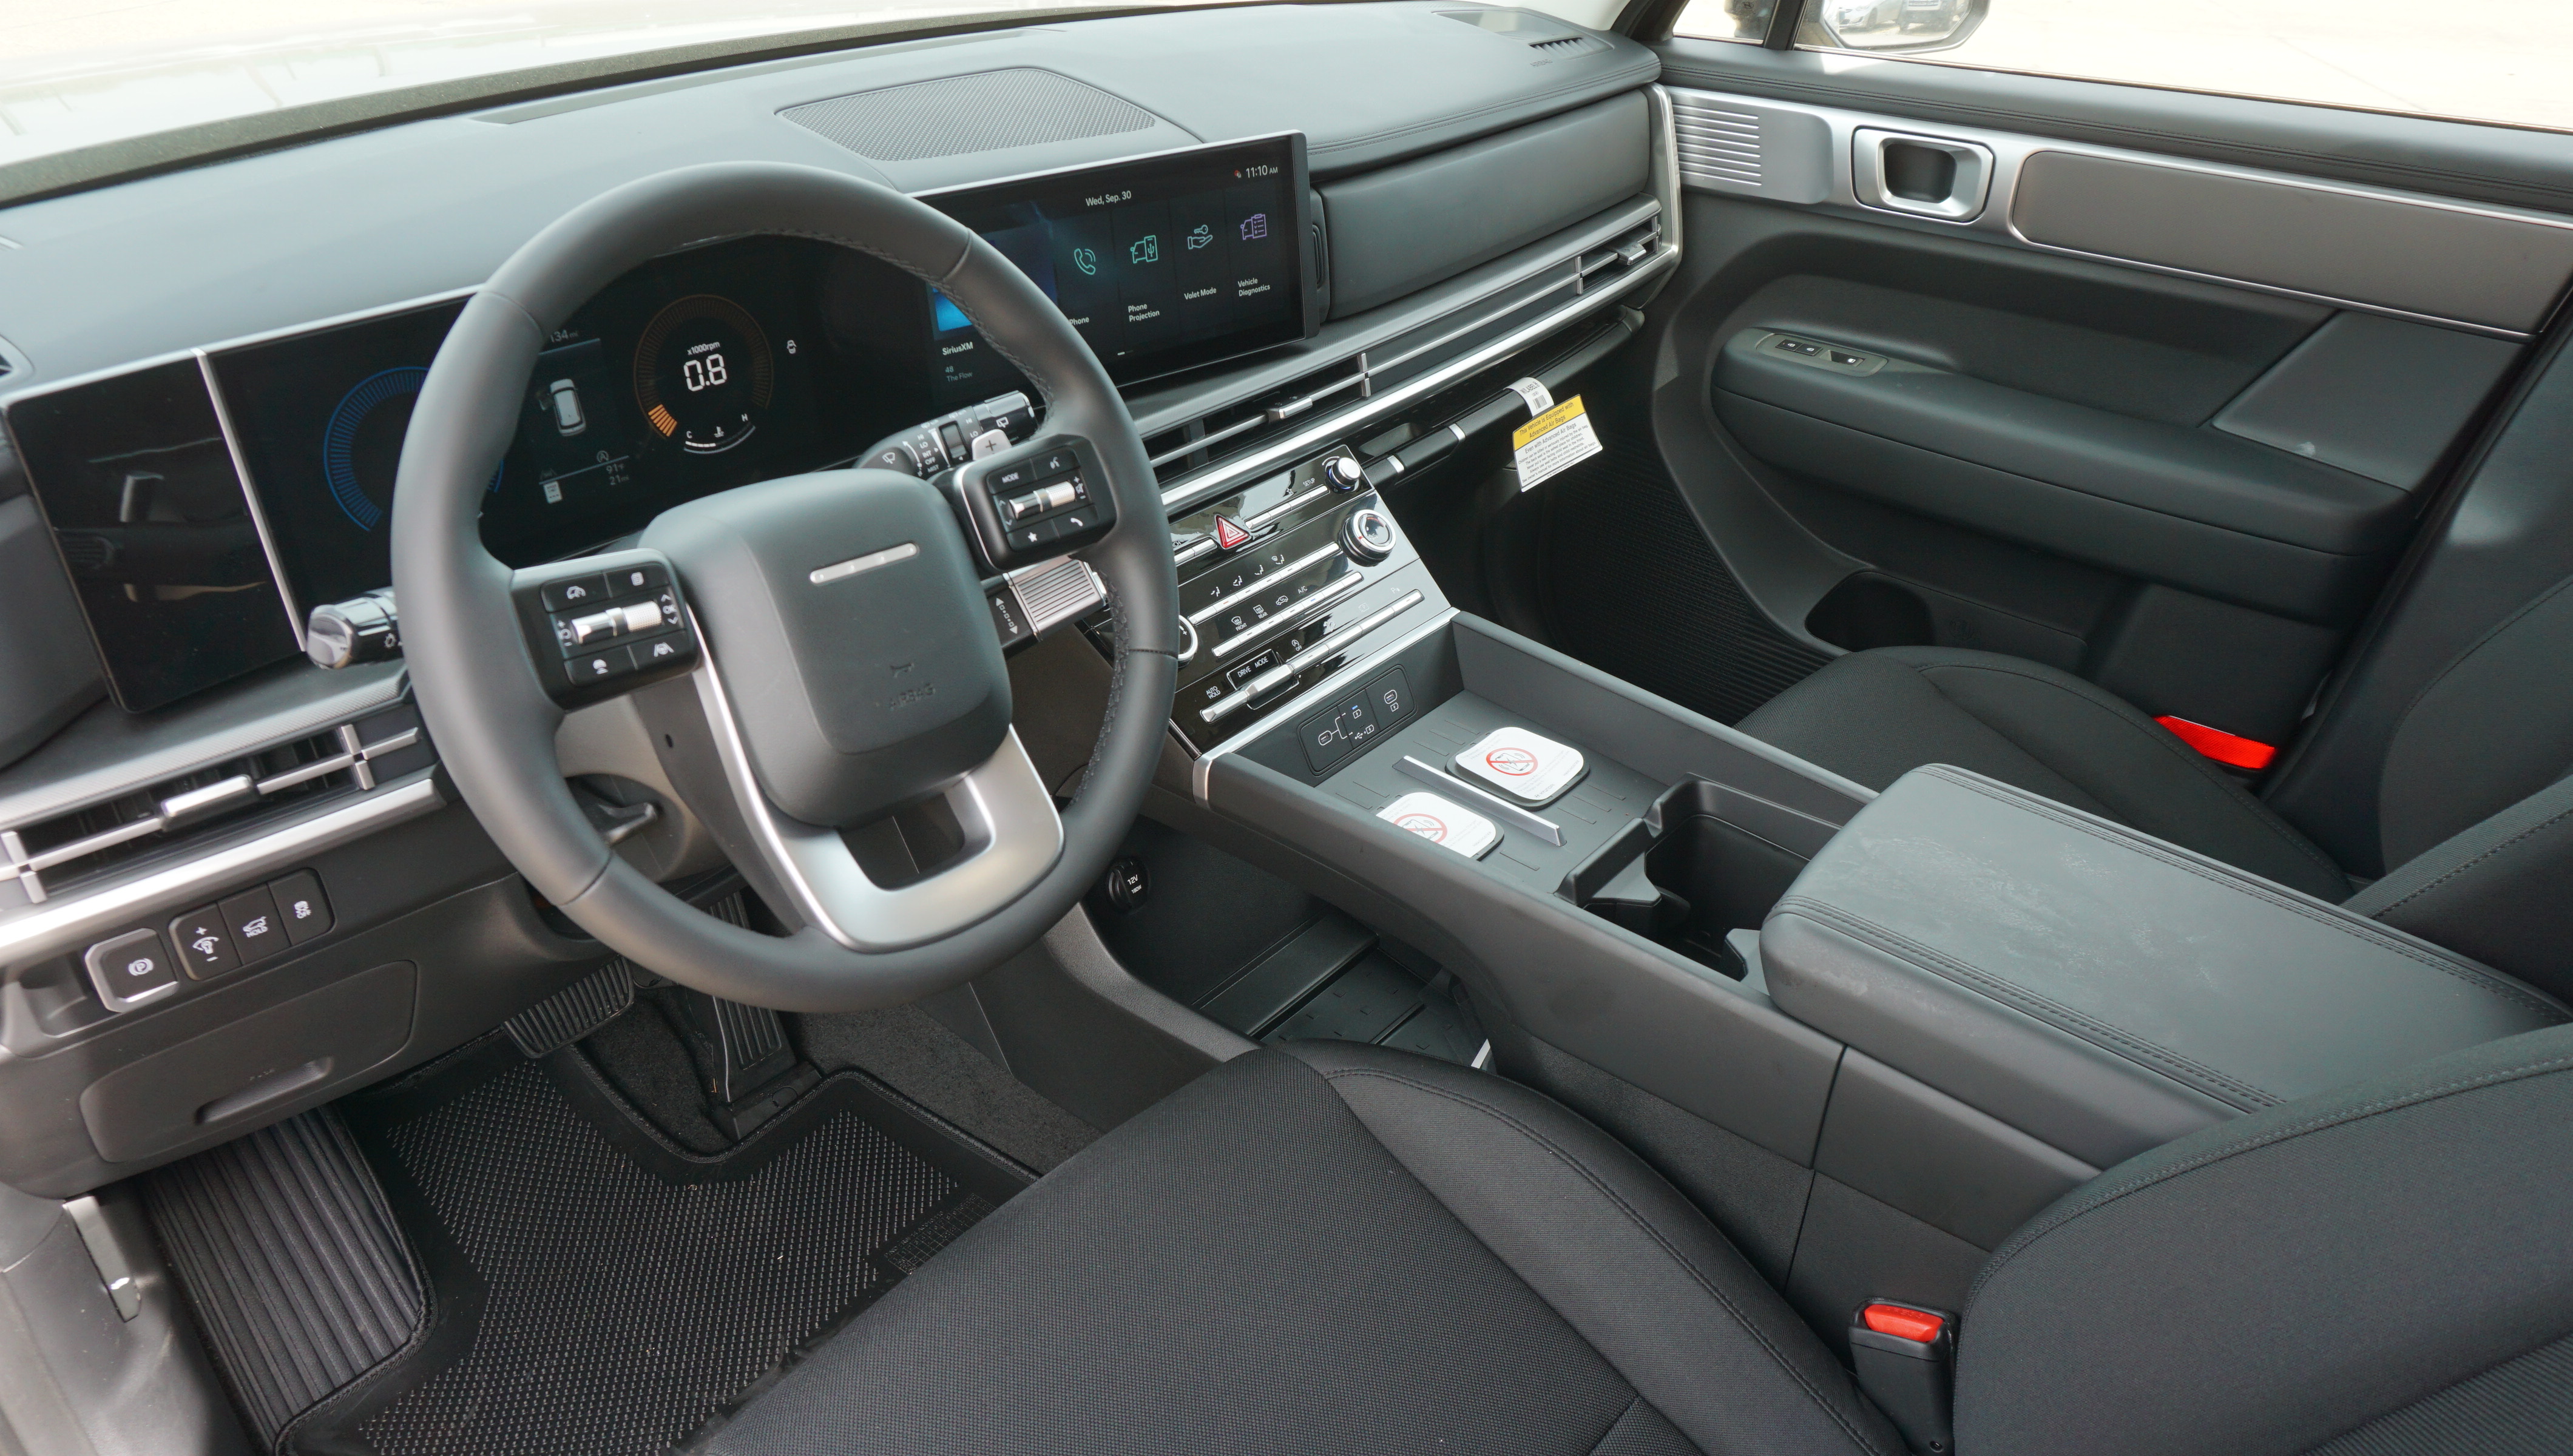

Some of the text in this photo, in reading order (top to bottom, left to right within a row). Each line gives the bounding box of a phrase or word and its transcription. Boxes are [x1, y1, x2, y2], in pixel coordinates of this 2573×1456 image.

[1246, 165, 1268, 178] 11:10
[1086, 190, 1132, 206] Wed, Sep. 30
[1238, 277, 1258, 288] Vehicle
[1184, 287, 1217, 300] Valet Mode
[1239, 283, 1271, 297] Diagnostics
[1128, 303, 1148, 313] Phone
[1129, 309, 1160, 322] Projection
[686, 342, 721, 356] x1000rpm
[942, 341, 973, 356] SiriusXM
[683, 353, 727, 392] 0.8
[959, 371, 973, 380] Flow
[741, 413, 748, 422] H
[1527, 419, 1541, 430] Vehicle
[1546, 408, 1564, 420] Equipped
[1529, 424, 1549, 439] Advanced
[1555, 415, 1566, 424] Bags
[1542, 431, 1560, 444] Advanced
[922, 450, 932, 458] INT
[924, 456, 936, 465] OFF
[1002, 472, 1019, 484] MODE
[1302, 477, 1316, 487] SETUP
[1297, 585, 1308, 595] A/C
[1236, 622, 1248, 632] FRONT
[1237, 656, 1269, 678] DRIVE MODE
[1206, 686, 1218, 695] AUTO
[1208, 690, 1221, 699] HOLD
[1127, 874, 1138, 885] 12V
